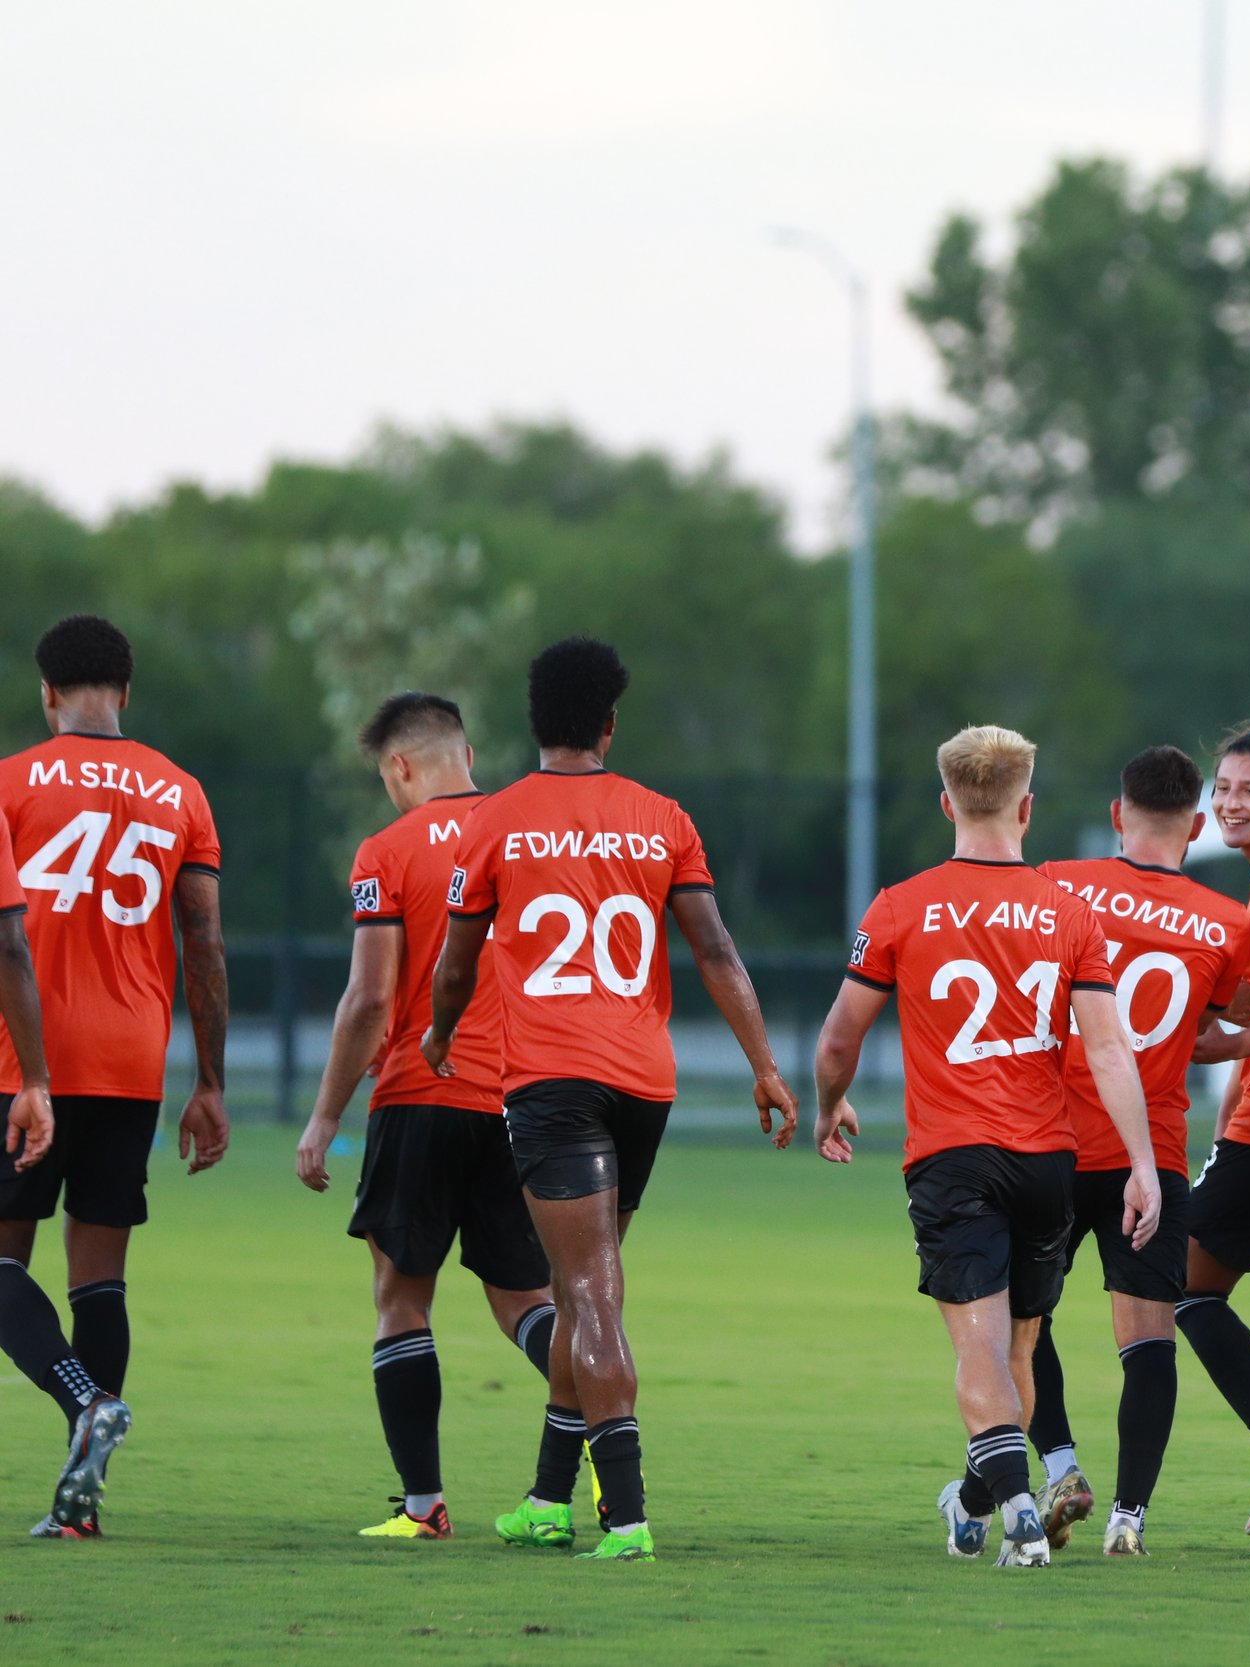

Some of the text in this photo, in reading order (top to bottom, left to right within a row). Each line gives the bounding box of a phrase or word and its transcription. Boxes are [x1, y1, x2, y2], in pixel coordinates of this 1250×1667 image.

[28, 759, 183, 811] M. SILVA
[17, 810, 177, 926] 45
[504, 830, 668, 861] EDWARDS
[518, 893, 657, 997] 20
[922, 901, 1057, 935] EVANS
[930, 959, 1062, 1065] 21
